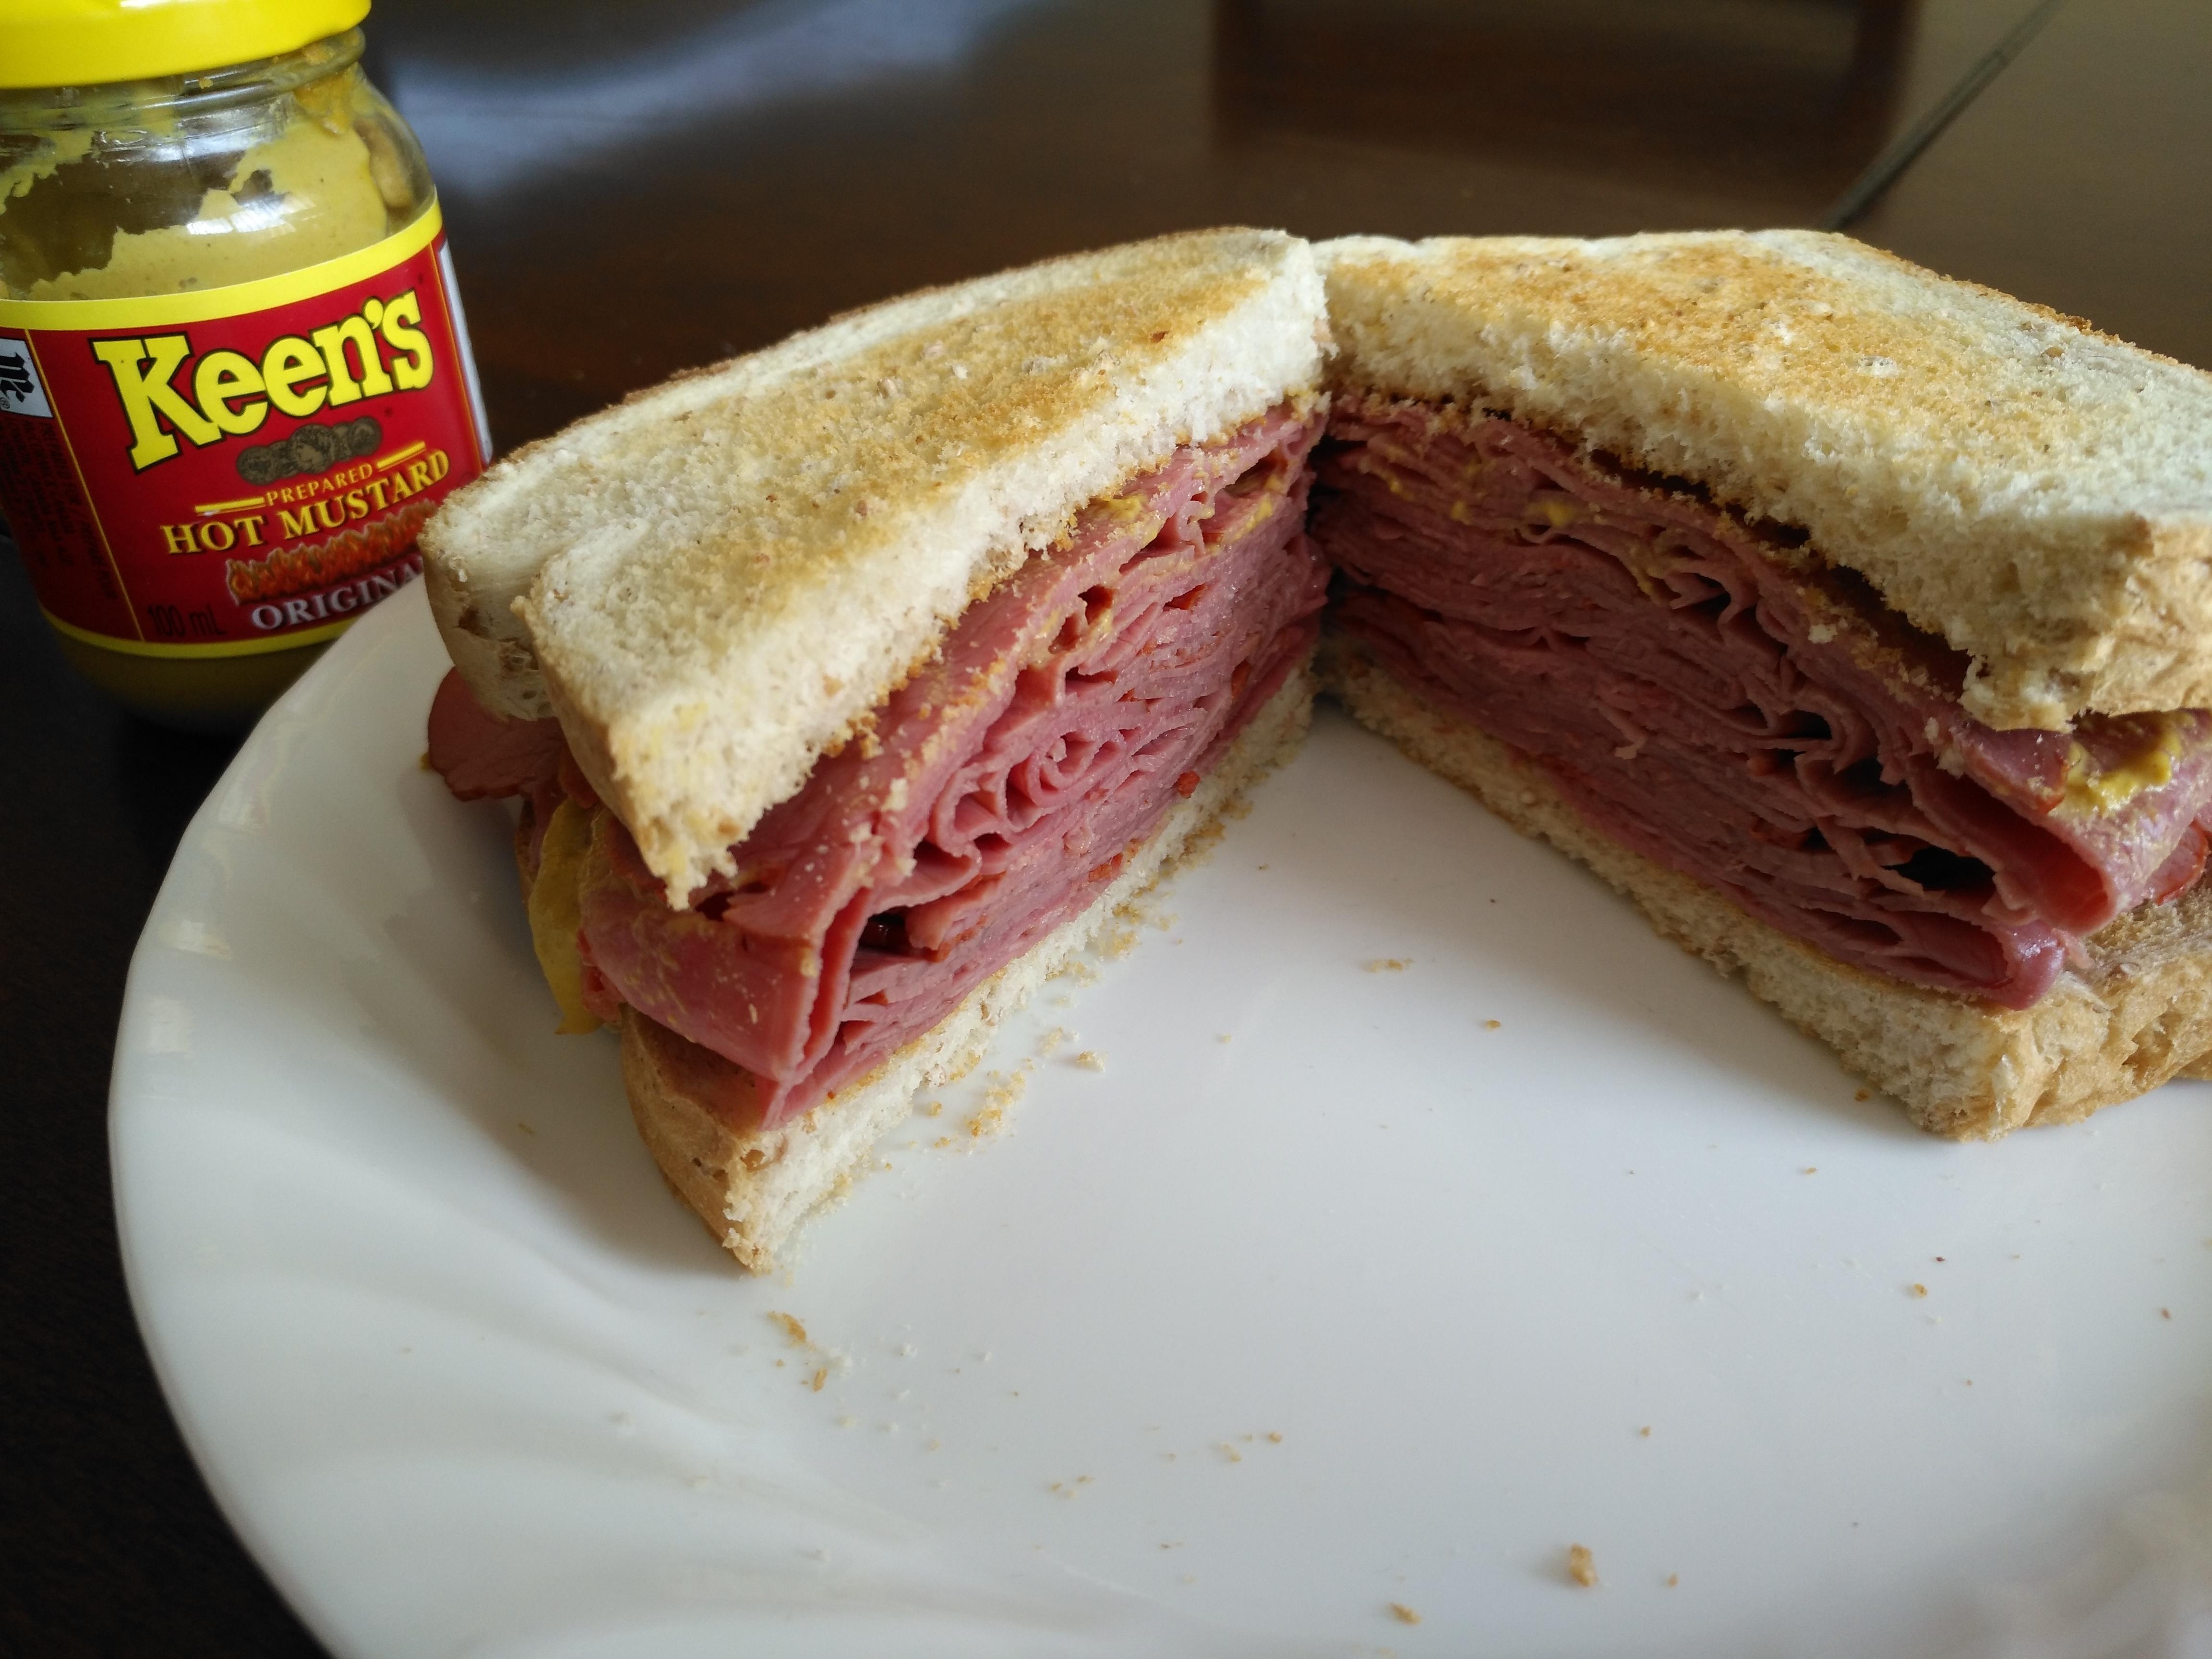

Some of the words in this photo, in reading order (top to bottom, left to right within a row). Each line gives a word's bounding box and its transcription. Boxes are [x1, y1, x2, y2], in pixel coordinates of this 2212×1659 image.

[89, 289, 433, 473] Keen's
[161, 515, 265, 554] HOT
[277, 449, 450, 540] MUSTARD
[265, 462, 373, 507] PREPARED
[147, 604, 186, 637] 100
